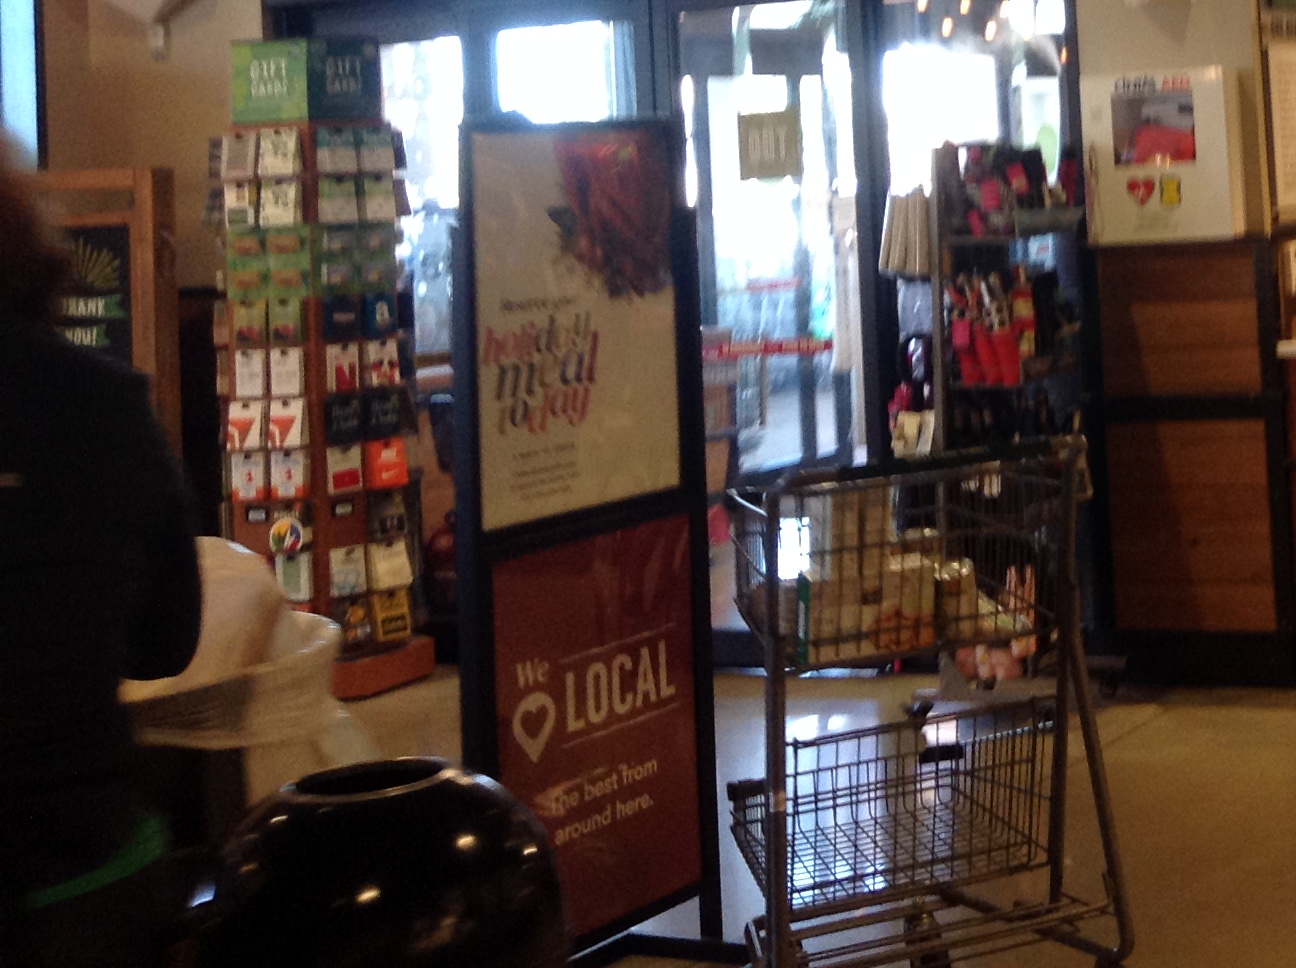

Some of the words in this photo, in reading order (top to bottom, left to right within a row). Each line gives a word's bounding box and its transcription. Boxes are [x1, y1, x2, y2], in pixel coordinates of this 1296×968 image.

[516, 659, 550, 689] We
[565, 639, 677, 732] LOCAL
[583, 772, 619, 801] best
[618, 758, 658, 786] from
[554, 803, 611, 846] around
[616, 793, 654, 820] here.
